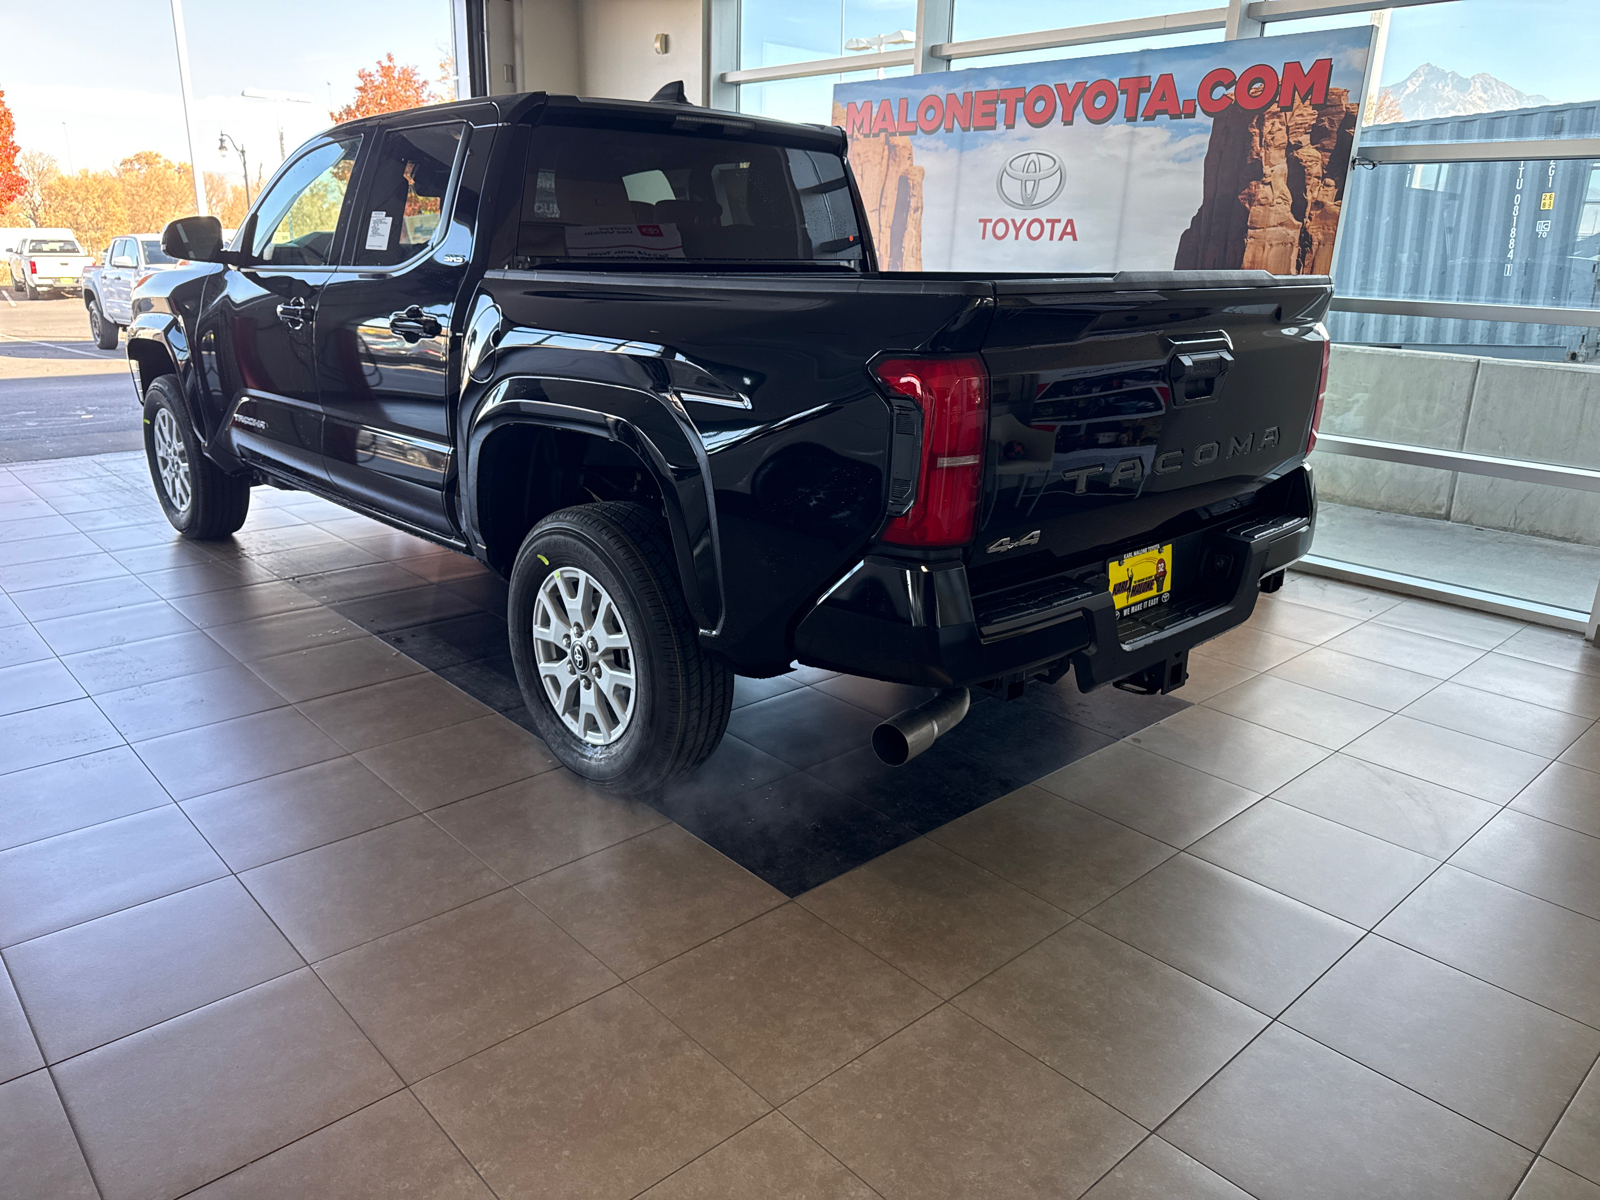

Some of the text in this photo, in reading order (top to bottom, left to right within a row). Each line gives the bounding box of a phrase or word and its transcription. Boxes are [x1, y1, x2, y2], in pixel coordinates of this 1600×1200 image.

[845, 58, 1334, 139] MALONETOYOTA.COM
[978, 217, 1078, 242] TOYOTA
[1507, 194, 1521, 260] 081884
[1062, 426, 1281, 494] TACOMA
[986, 529, 1041, 554] 4x4
[1124, 551, 1133, 559] KARL
[1133, 547, 1148, 556] MALONE
[1158, 563, 1164, 572] 32
[1123, 607, 1130, 617] WE
[1130, 602, 1143, 614] MAKE
[1148, 596, 1159, 607] EASY
